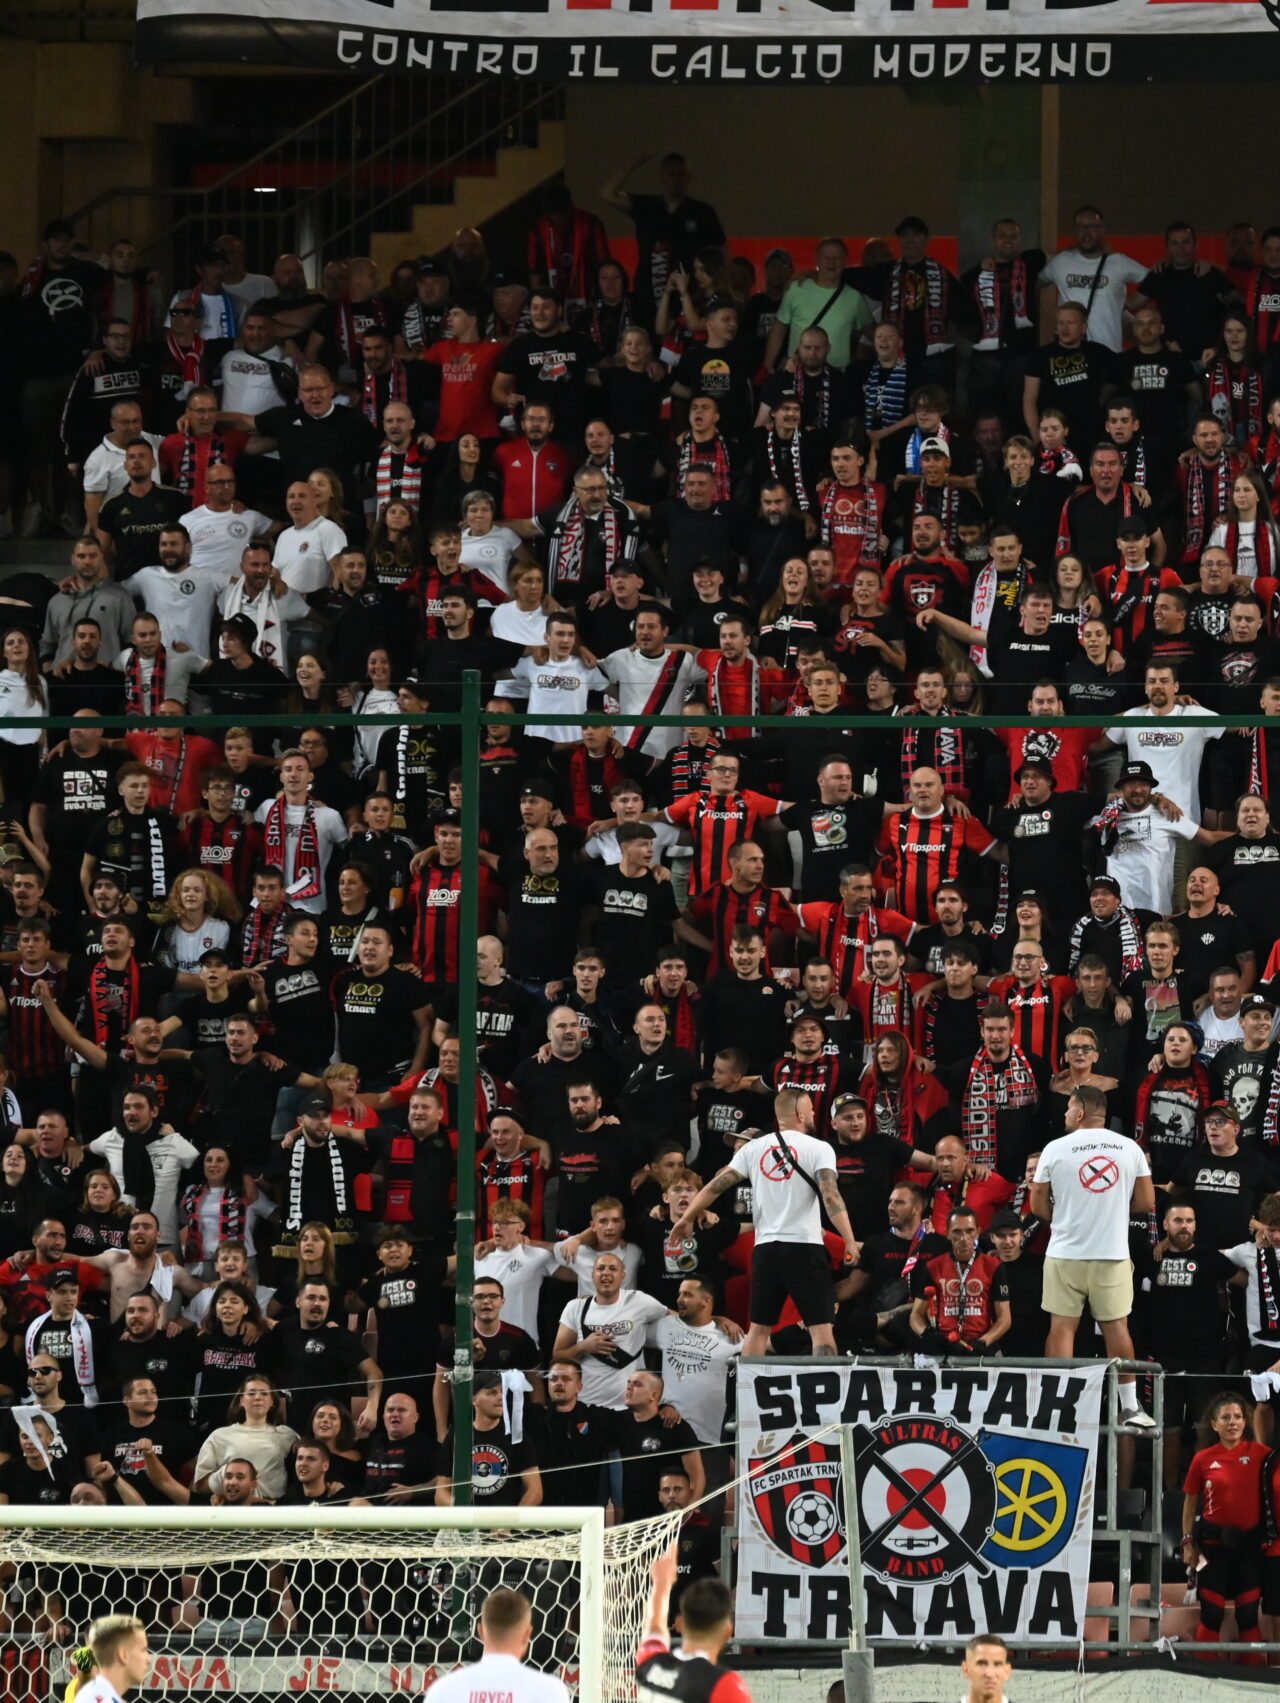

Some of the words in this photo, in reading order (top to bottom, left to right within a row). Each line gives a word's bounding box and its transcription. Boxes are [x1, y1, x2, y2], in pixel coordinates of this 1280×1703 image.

[336, 28, 539, 75] CONTRO
[567, 44, 620, 78] IL
[650, 43, 844, 80] CALCIO
[872, 42, 1113, 79] MODERNO
[551, 352, 577, 364] TOUR
[1134, 365, 1159, 377] FCST
[102, 371, 140, 390] SUPER
[1142, 376, 1166, 389] 1923
[131, 522, 163, 535] Tipspo
[542, 675, 579, 688] 1923
[1141, 732, 1181, 744] 1923
[707, 809, 744, 822] Tipsport
[1024, 821, 1050, 836] 1923
[200, 846, 235, 861] ZOS
[909, 842, 947, 854] Tipsport
[427, 888, 462, 904] ZOS
[345, 981, 384, 998] 100
[17, 996, 44, 1009] Tipsp
[476, 1011, 515, 1031] ARTAK
[709, 1104, 735, 1118] FCST
[713, 1117, 738, 1132] 1923
[1071, 1144, 1100, 1154] SPARTAK
[1100, 1142, 1124, 1151] TRNAVA
[493, 1174, 528, 1187] psport
[73, 1223, 125, 1248] SPATAK
[1160, 1258, 1187, 1271] FCST
[1167, 1271, 1194, 1286] 1923
[381, 1280, 405, 1296] FCST
[389, 1291, 416, 1307] 1923
[40, 1330, 67, 1344] FCST
[47, 1345, 72, 1358] 1923
[666, 1356, 710, 1375] ATHLETIC
[753, 1369, 1087, 1434] SPARTAK
[880, 1423, 962, 1451] ULTRAS
[754, 1480, 767, 1495] FC
[768, 1470, 813, 1489] SPARTAK
[885, 1555, 945, 1577] BAND
[751, 1569, 1078, 1639] TRNAVA
[151, 1656, 232, 1691] AVA
[288, 1657, 341, 1690] JE
